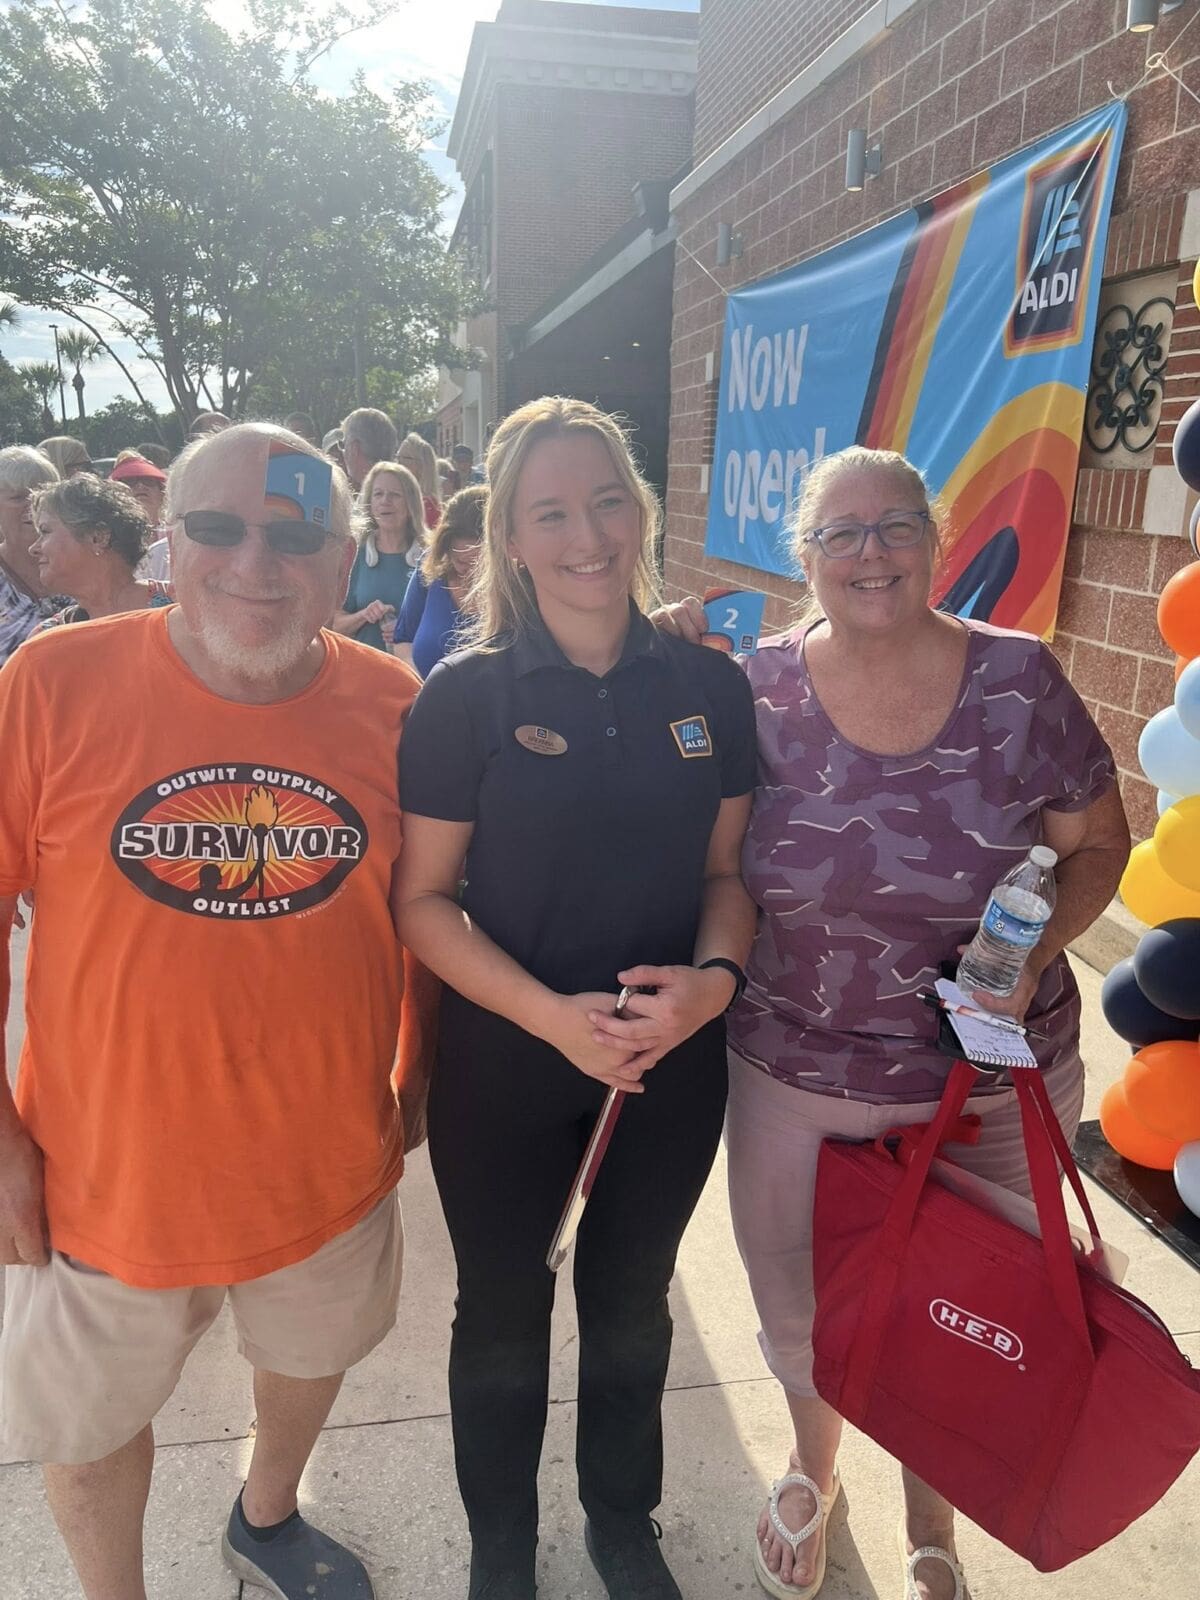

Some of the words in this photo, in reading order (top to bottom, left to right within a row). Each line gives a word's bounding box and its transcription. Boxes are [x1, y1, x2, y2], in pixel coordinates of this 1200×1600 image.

[1020, 268, 1078, 314] ALDI
[294, 472, 305, 496] 1
[723, 608, 739, 629] 2
[685, 739, 707, 749] ALDI
[157, 768, 237, 796] OUTWIT
[252, 768, 337, 804] OUTPLAY
[119, 823, 361, 862] SURVIVOR
[193, 898, 290, 916] OUTLAST
[940, 1306, 1012, 1352] H-E-B
